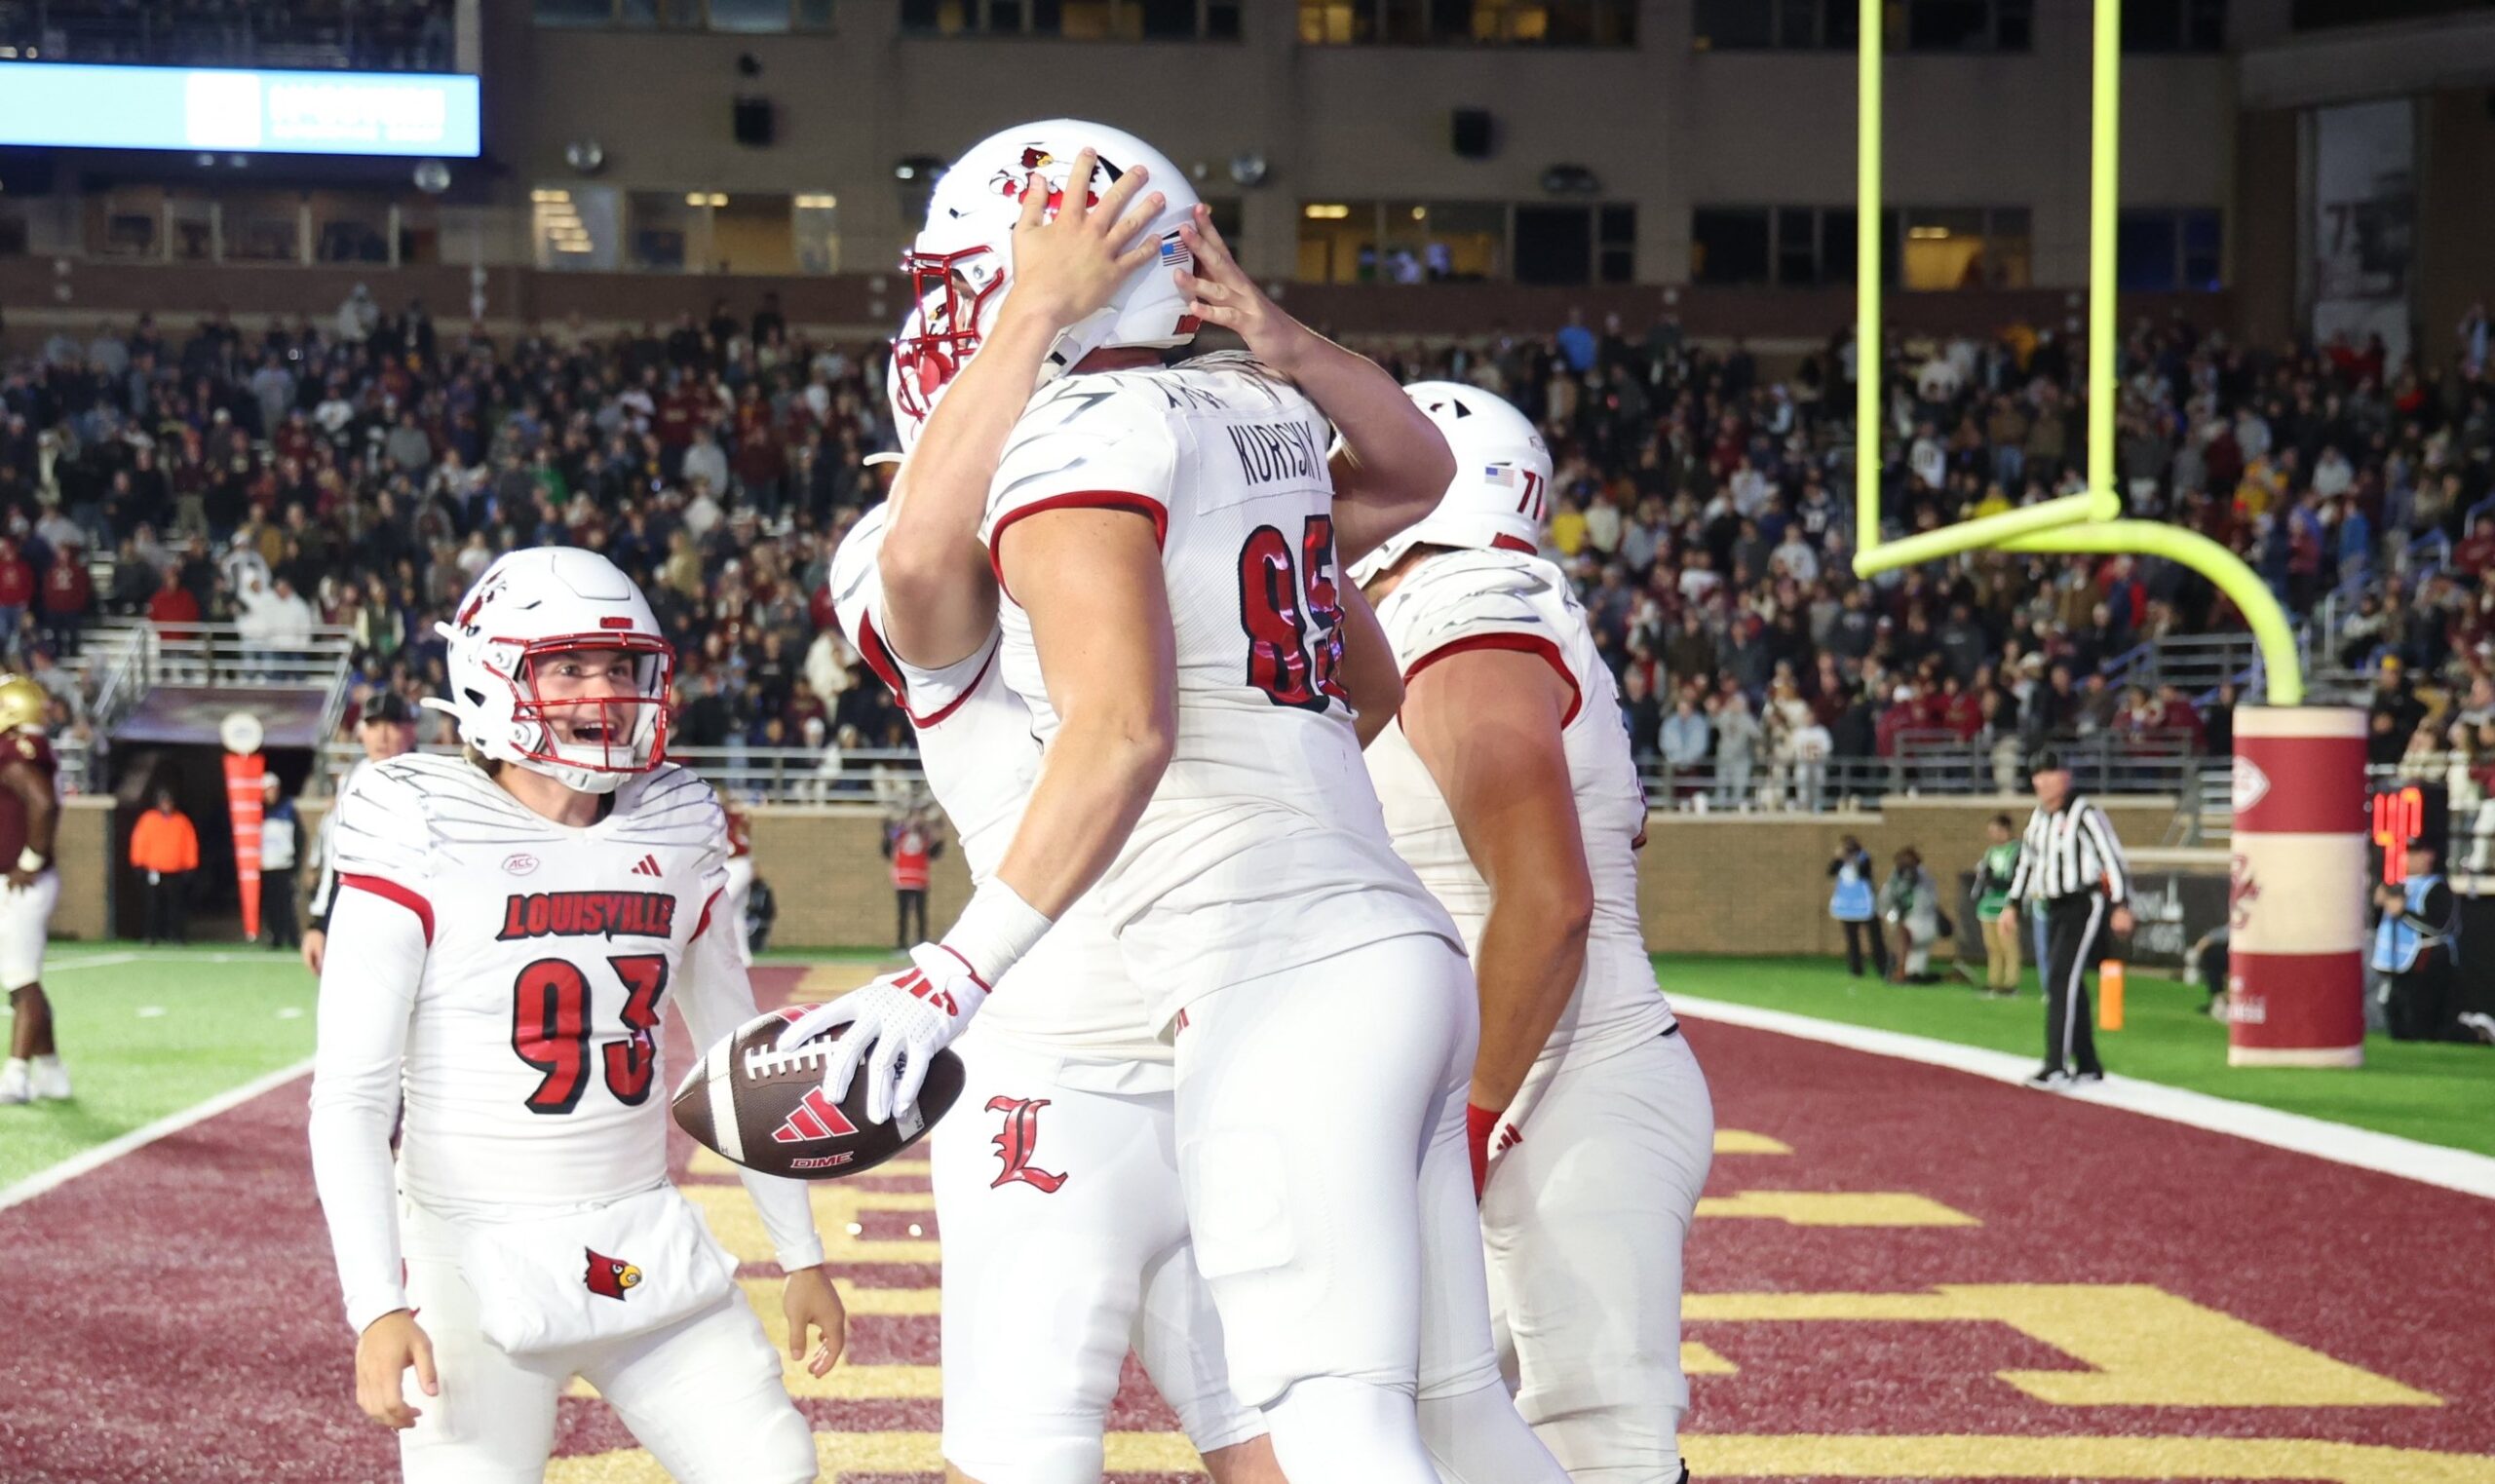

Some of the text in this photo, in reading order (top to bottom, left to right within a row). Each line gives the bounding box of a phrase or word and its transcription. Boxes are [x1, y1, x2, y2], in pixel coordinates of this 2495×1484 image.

[1517, 470, 1543, 520] 71
[1239, 514, 1351, 713] 85
[506, 856, 535, 871] ACC
[495, 892, 675, 942] LOUISVILLE
[512, 953, 669, 1114] 93
[790, 1152, 854, 1168] DIME
[984, 1095, 1068, 1194] L
